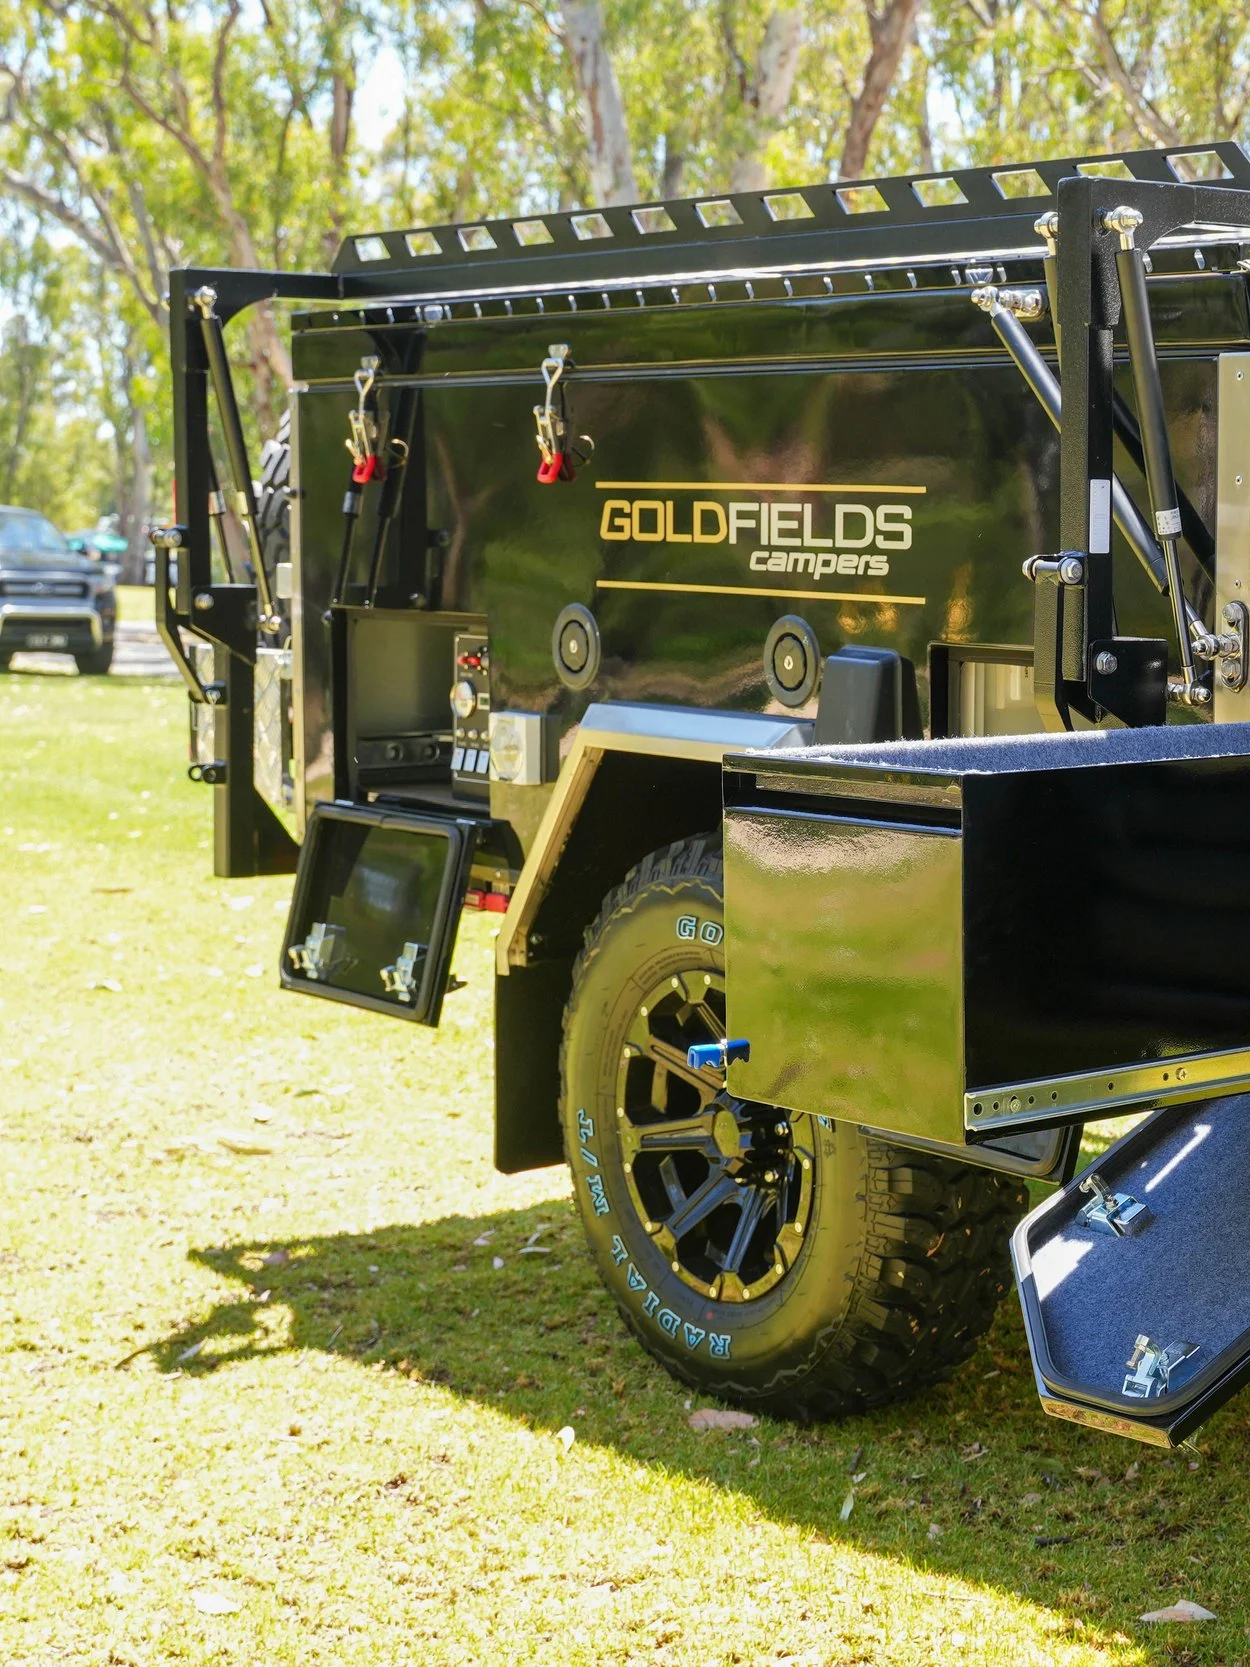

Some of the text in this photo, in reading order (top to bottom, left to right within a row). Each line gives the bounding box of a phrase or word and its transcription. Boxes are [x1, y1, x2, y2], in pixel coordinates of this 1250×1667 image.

[600, 499, 913, 550] GOLDFIELDS
[749, 550, 890, 580] campers
[676, 915, 724, 946] GO
[576, 1108, 732, 1361] RADIAL M/T
